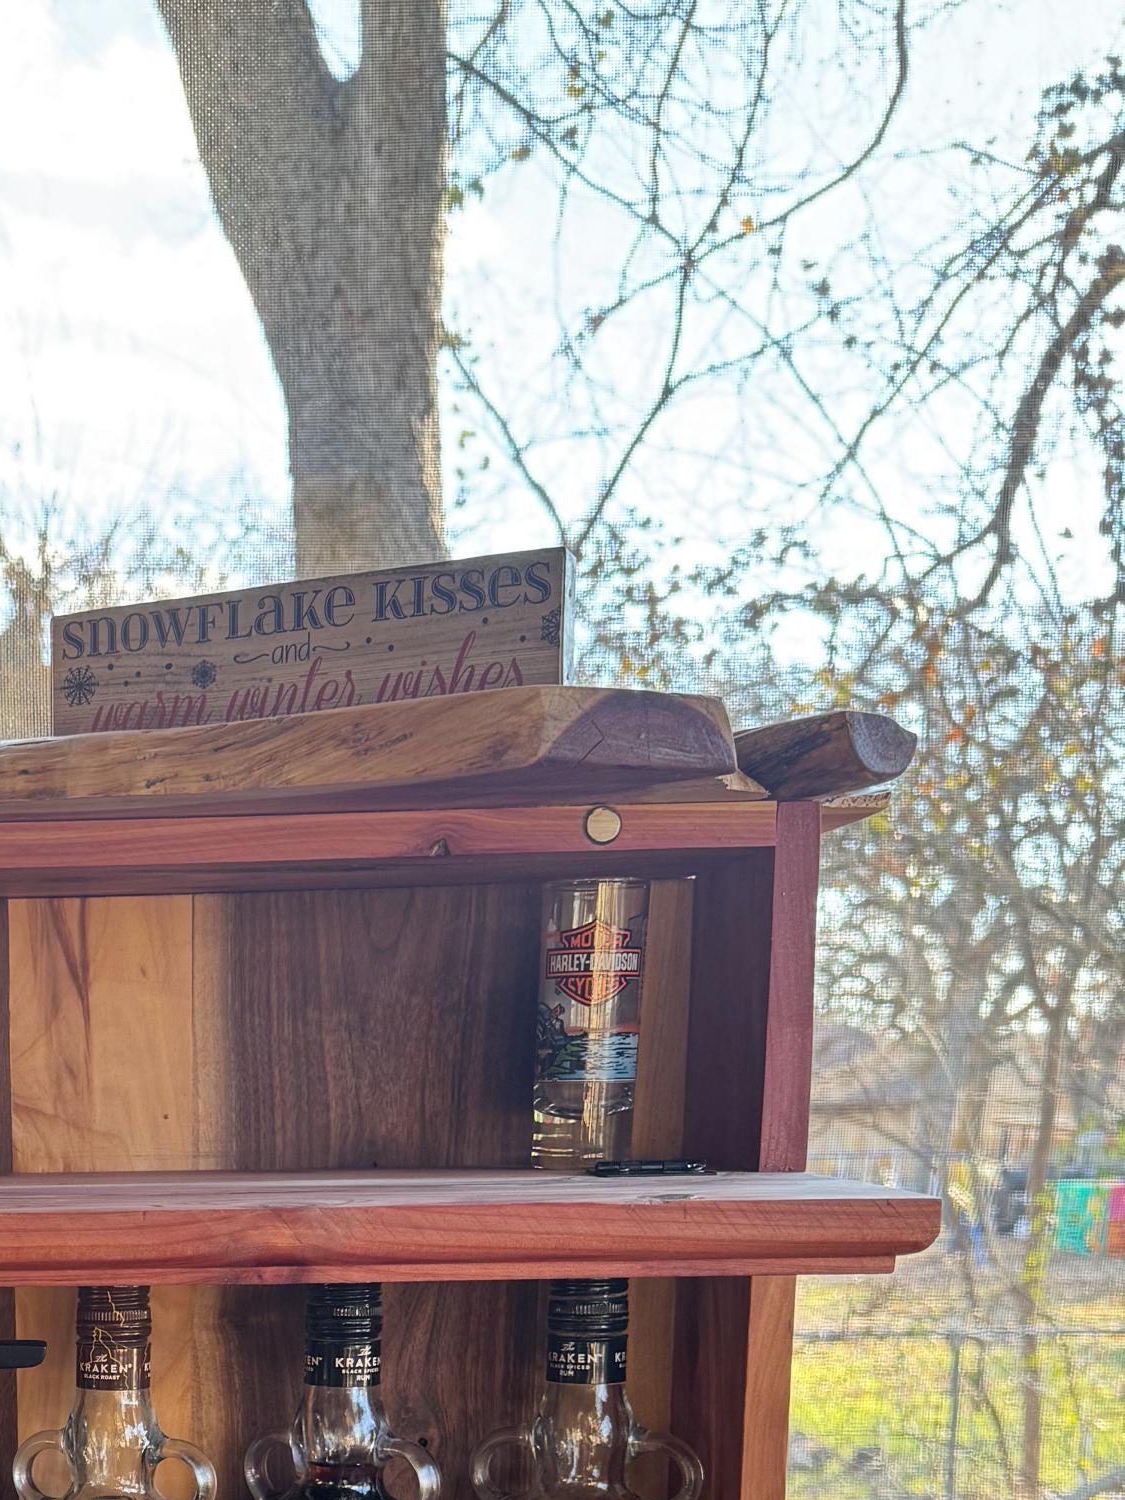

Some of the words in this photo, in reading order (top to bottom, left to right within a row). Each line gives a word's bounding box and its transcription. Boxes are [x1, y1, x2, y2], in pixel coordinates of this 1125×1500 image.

[271, 632, 311, 664] and
[225, 656, 362, 721] winter
[377, 630, 524, 704] wishes
[549, 952, 638, 972] HARLEY-DAVIDSON
[80, 1362, 128, 1374] KRAKEN
